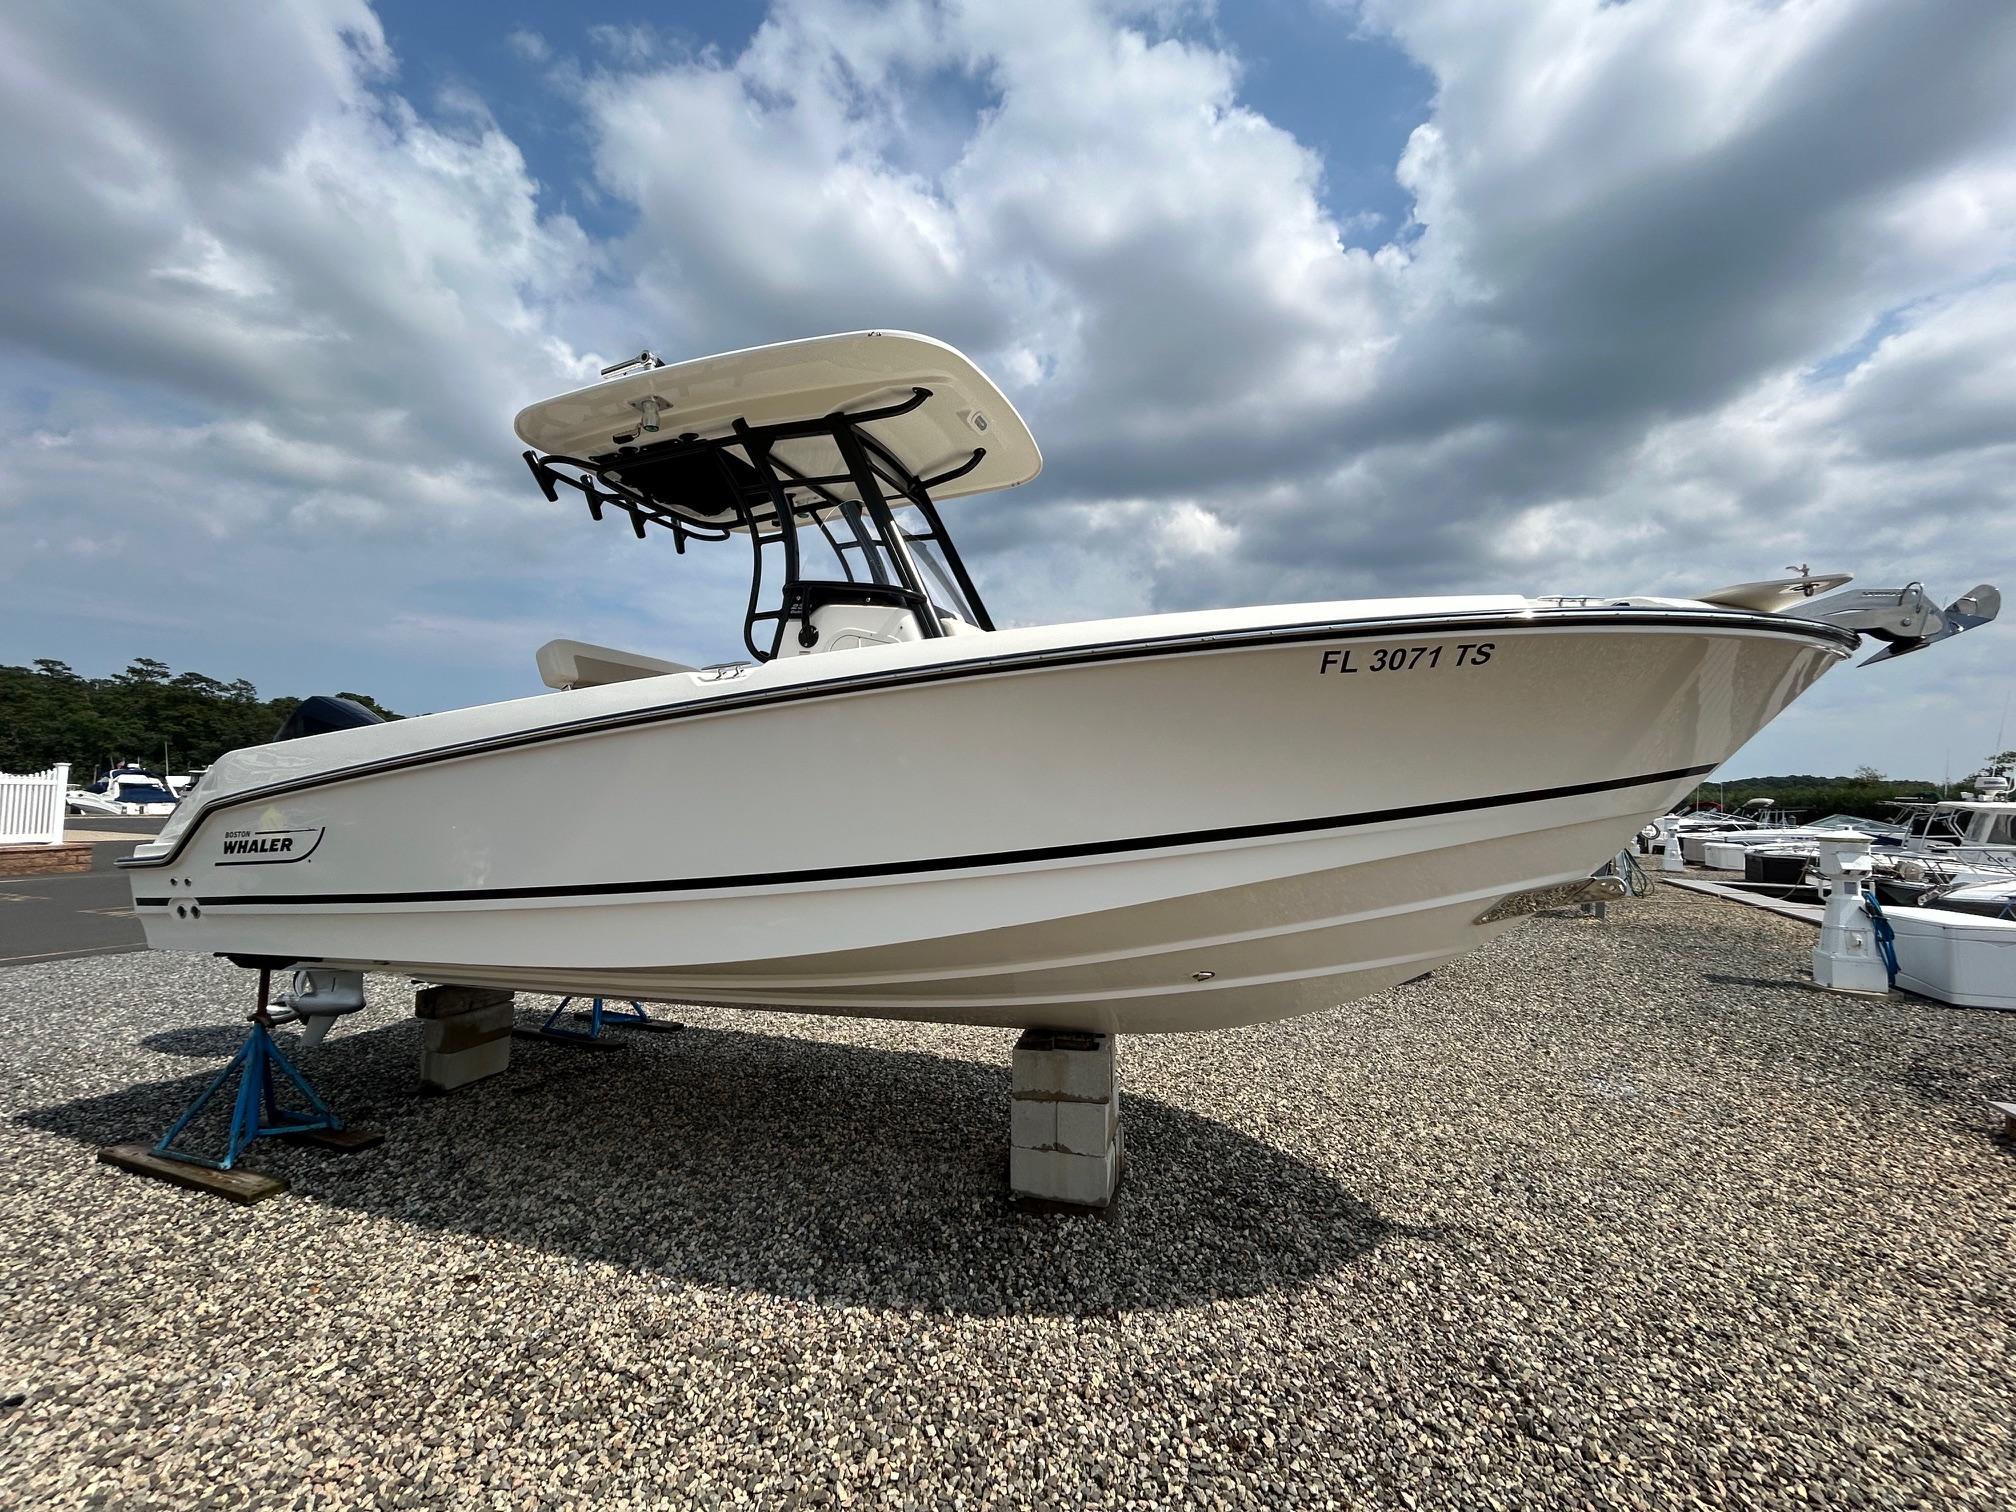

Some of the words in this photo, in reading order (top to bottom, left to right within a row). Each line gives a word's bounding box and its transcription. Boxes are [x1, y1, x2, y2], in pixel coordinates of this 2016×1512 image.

[1320, 650, 1358, 674] FL
[1369, 645, 1443, 672] 3071
[1456, 643, 1495, 667] TS
[223, 838, 293, 855] WHALER
